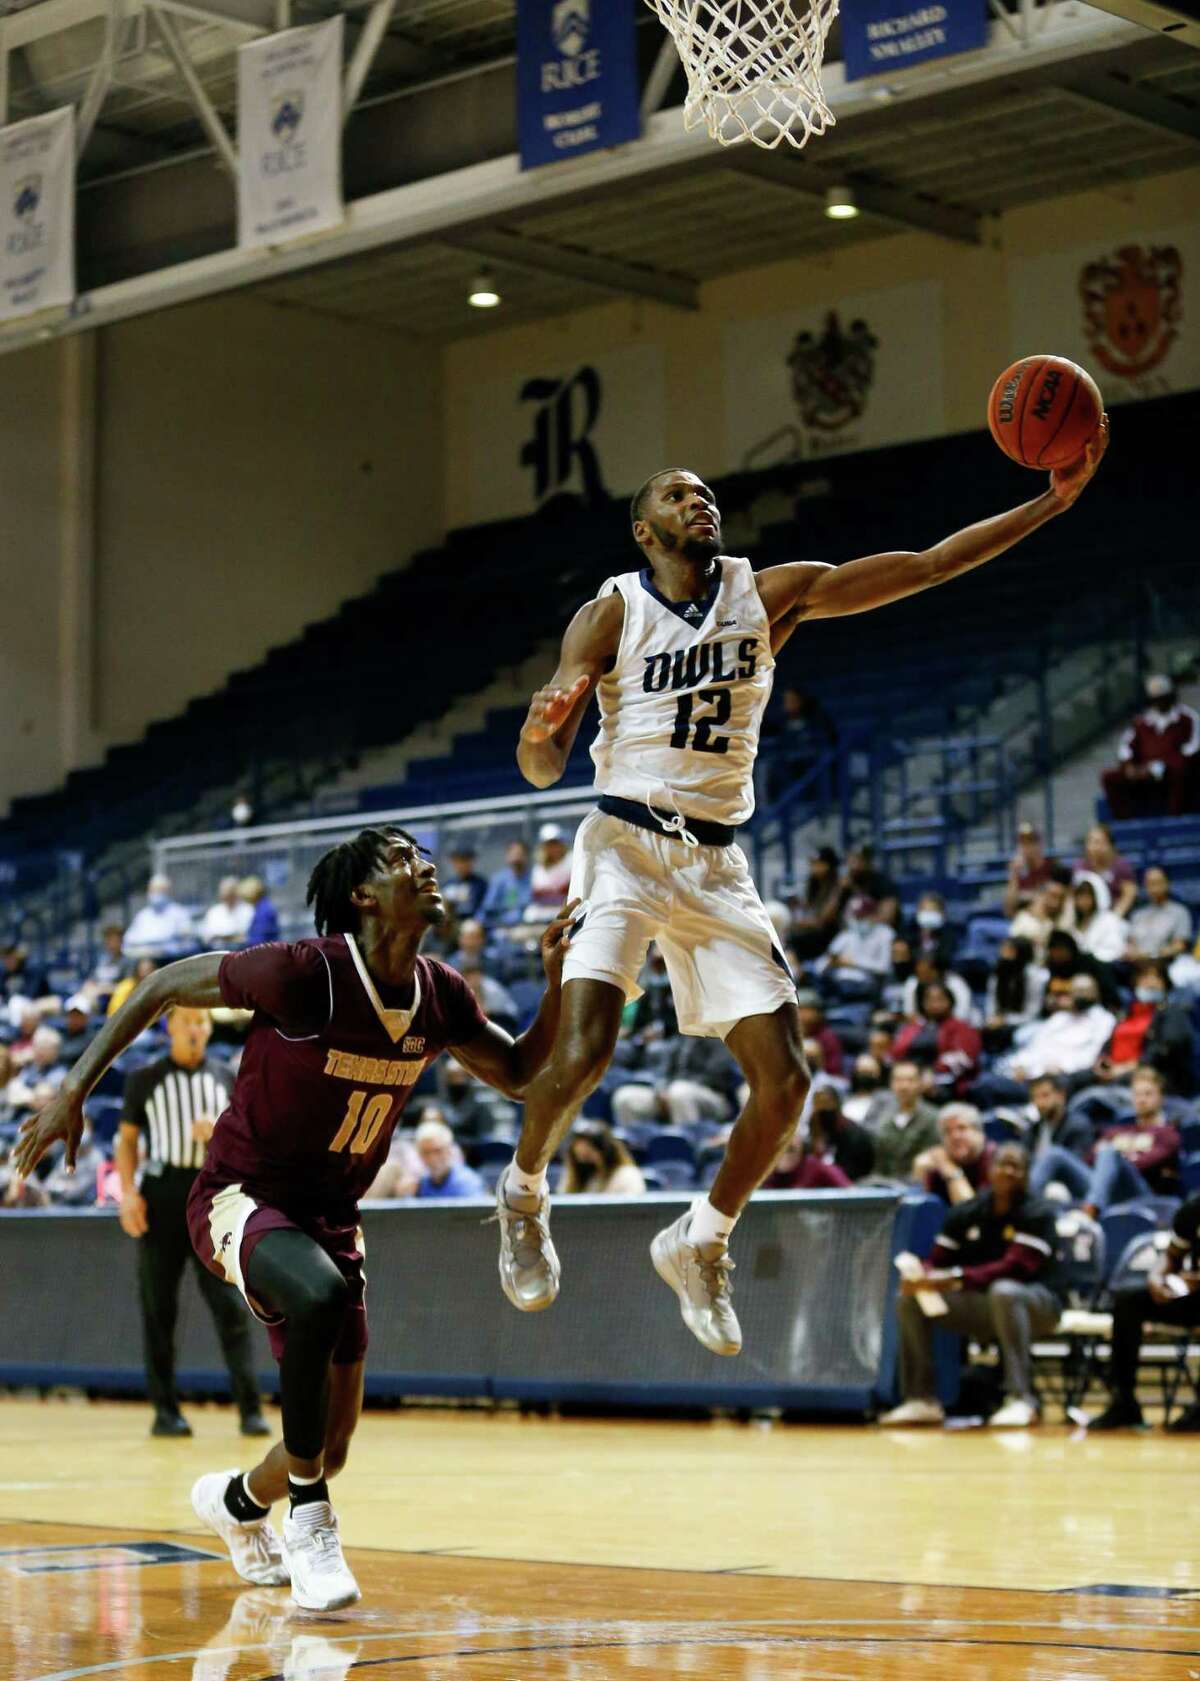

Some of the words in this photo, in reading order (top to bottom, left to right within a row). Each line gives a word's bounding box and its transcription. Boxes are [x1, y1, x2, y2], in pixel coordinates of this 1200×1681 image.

[541, 49, 600, 92] RICE
[1031, 369, 1064, 420] NCAA
[643, 638, 760, 693] OWLS
[670, 688, 731, 754] 12
[383, 1056, 428, 1086] STA
[328, 1090, 393, 1154] 10
